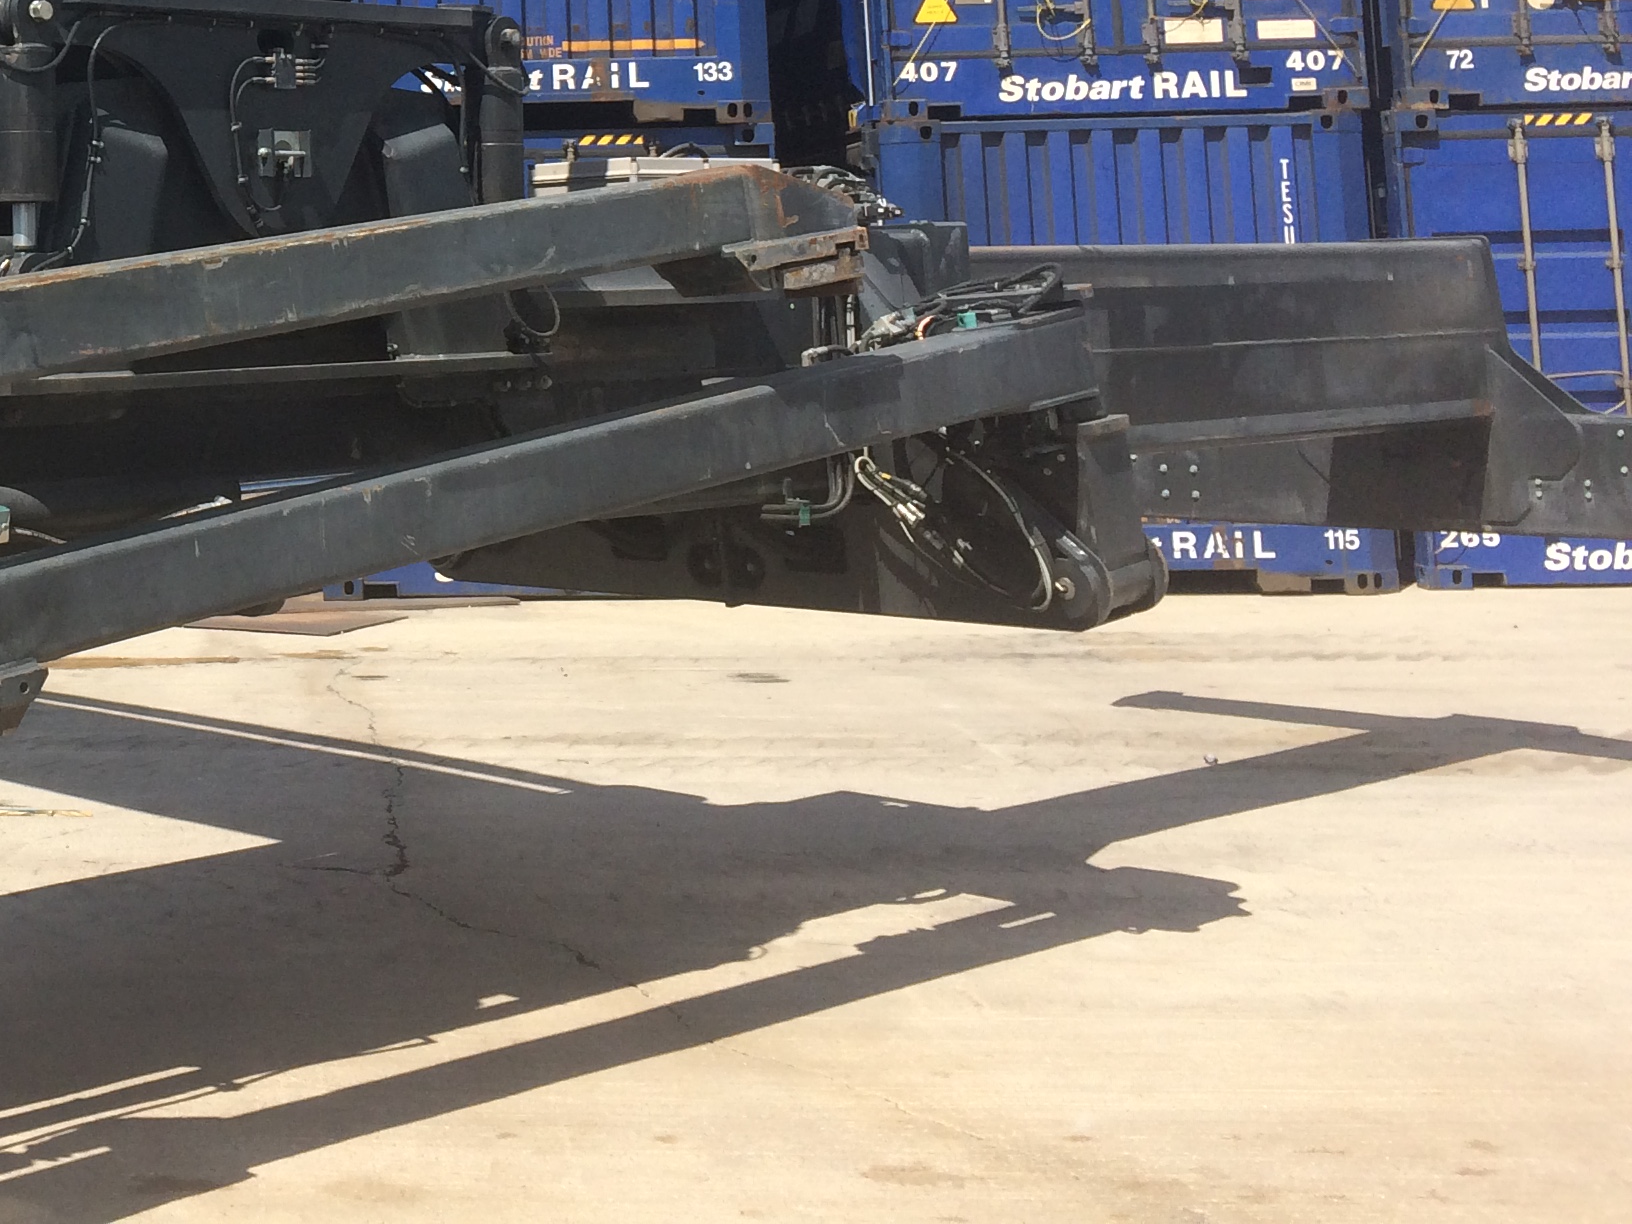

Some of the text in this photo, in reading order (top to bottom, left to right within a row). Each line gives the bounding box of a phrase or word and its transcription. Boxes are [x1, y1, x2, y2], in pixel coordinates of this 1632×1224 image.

[693, 62, 733, 82] 133
[899, 50, 1344, 103] 407 Stobart RAIL 407
[1446, 49, 1632, 92] 72 Stobar
[1279, 158, 1295, 244] TESU
[1172, 529, 1360, 559] RAIL 115
[1543, 542, 1632, 571] Stob
